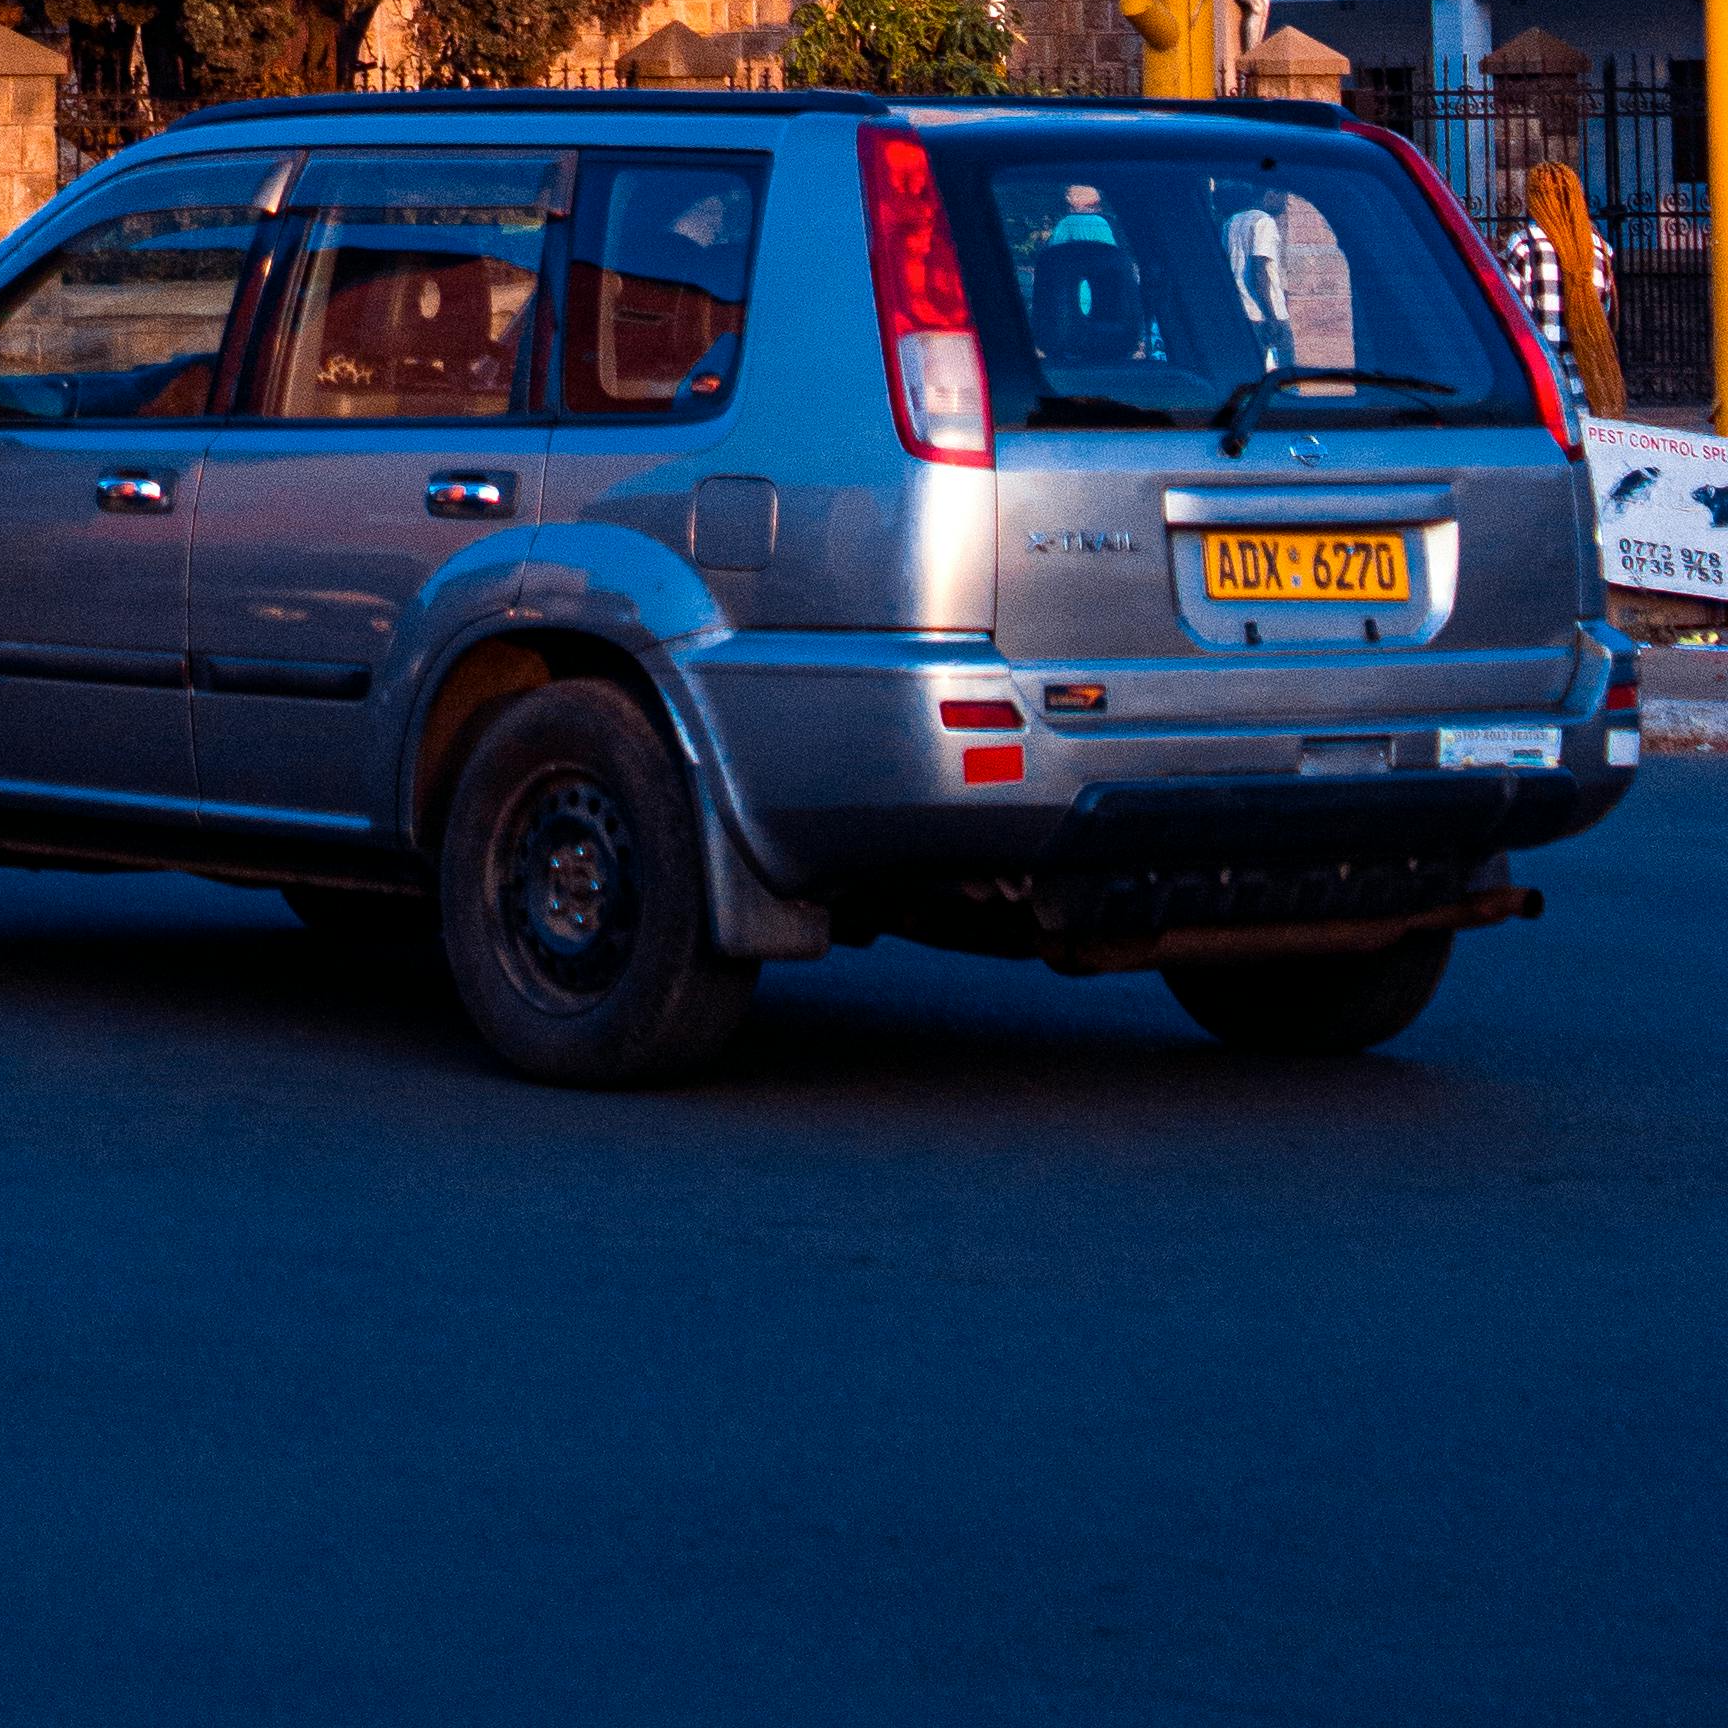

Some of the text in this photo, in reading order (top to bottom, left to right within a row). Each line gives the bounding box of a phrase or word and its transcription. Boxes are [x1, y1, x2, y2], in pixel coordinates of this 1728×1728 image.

[1588, 427, 1624, 444] PEST
[1629, 433, 1699, 458] CONTROL
[1217, 538, 1397, 591] ADX 6270
[1622, 555, 1723, 584] 0735 753
[1680, 548, 1722, 568] 978
